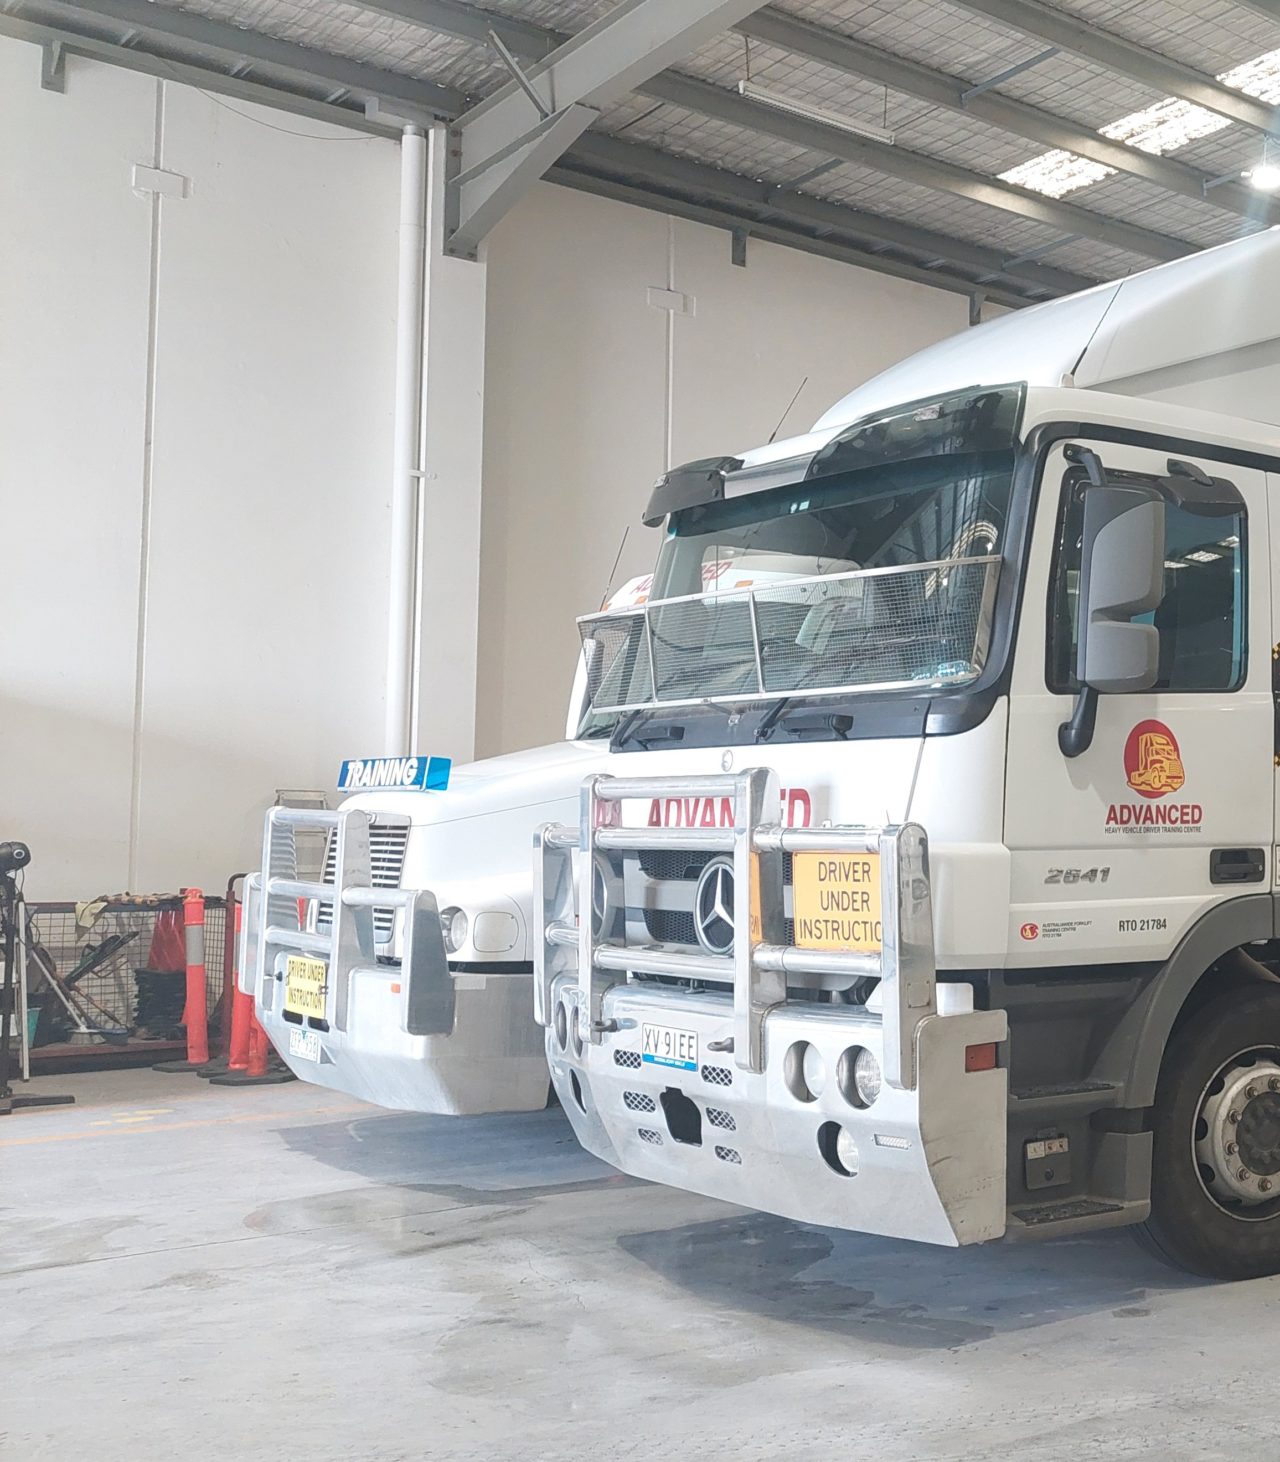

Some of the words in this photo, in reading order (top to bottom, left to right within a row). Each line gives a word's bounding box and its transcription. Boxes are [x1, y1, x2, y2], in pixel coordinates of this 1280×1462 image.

[344, 758, 418, 787] TRAINING
[1106, 804, 1202, 825] ADVANCED
[1104, 826, 1120, 834] HEAVY
[1122, 826, 1142, 834] VEHICLE
[818, 861, 871, 882] DRIVER
[1044, 867, 1110, 884] 2641
[820, 890, 870, 912] UNDER
[800, 918, 882, 942] INSTRUCTIO
[1118, 920, 1137, 932] RTO
[1140, 918, 1167, 931] 21784
[288, 960, 306, 978] DRIVER
[308, 965, 324, 982] UNDER
[288, 987, 322, 1010] INSTRUCTION
